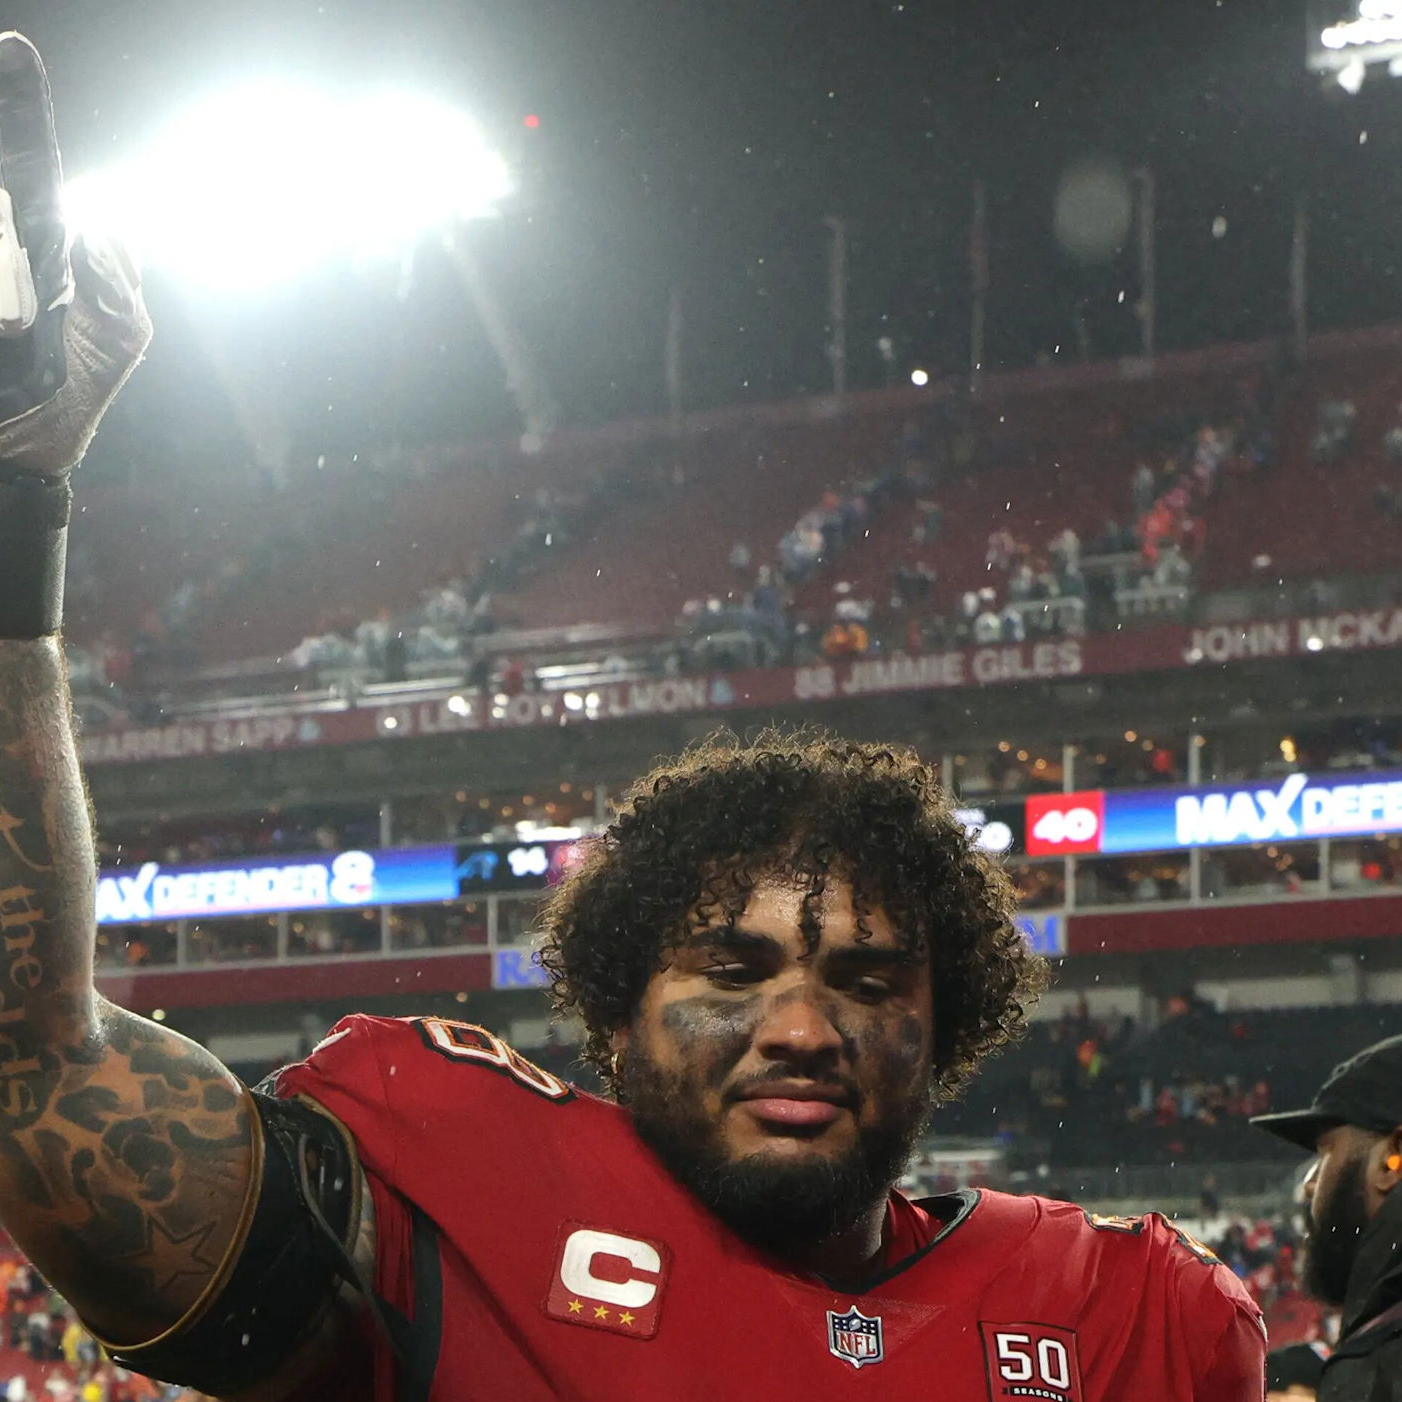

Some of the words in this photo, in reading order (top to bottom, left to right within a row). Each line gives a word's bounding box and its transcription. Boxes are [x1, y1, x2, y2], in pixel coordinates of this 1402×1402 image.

[971, 641, 1083, 684] GILES
[1032, 806, 1099, 843] 40
[1175, 773, 1308, 845] MAX
[95, 861, 160, 922] AX
[151, 863, 329, 916] DEFENDER
[560, 1228, 663, 1309] C
[838, 1331, 877, 1356] NFL
[995, 1332, 1071, 1391] 50
[1013, 1386, 1064, 1402] SEASONS
